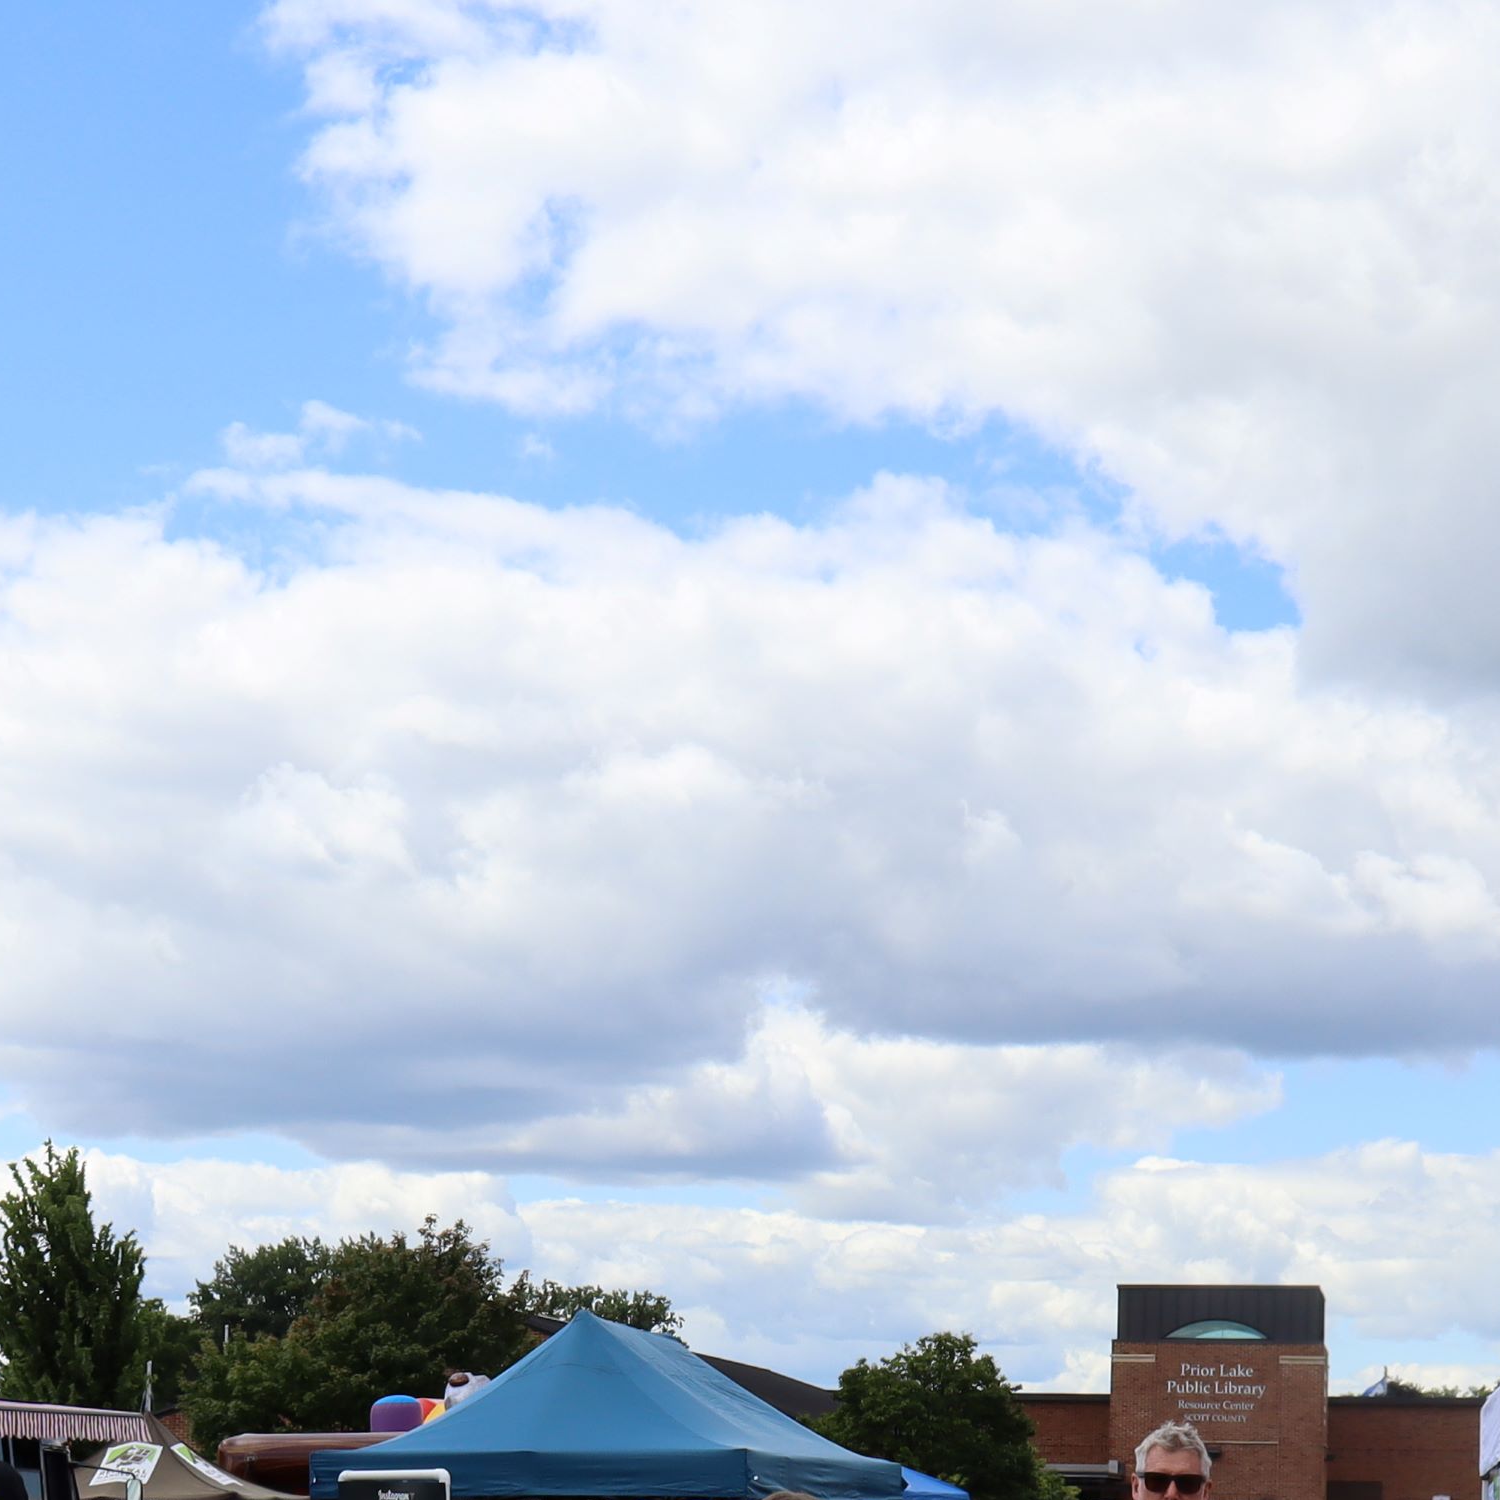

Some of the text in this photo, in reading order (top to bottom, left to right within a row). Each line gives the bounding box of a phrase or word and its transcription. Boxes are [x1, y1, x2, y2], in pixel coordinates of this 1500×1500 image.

[1180, 1363, 1254, 1378] Prior Lake
[1167, 1380, 1266, 1399] Public Library
[1178, 1399, 1254, 1411] Resource Center
[1183, 1413, 1248, 1423] SCOTT COUNTY
